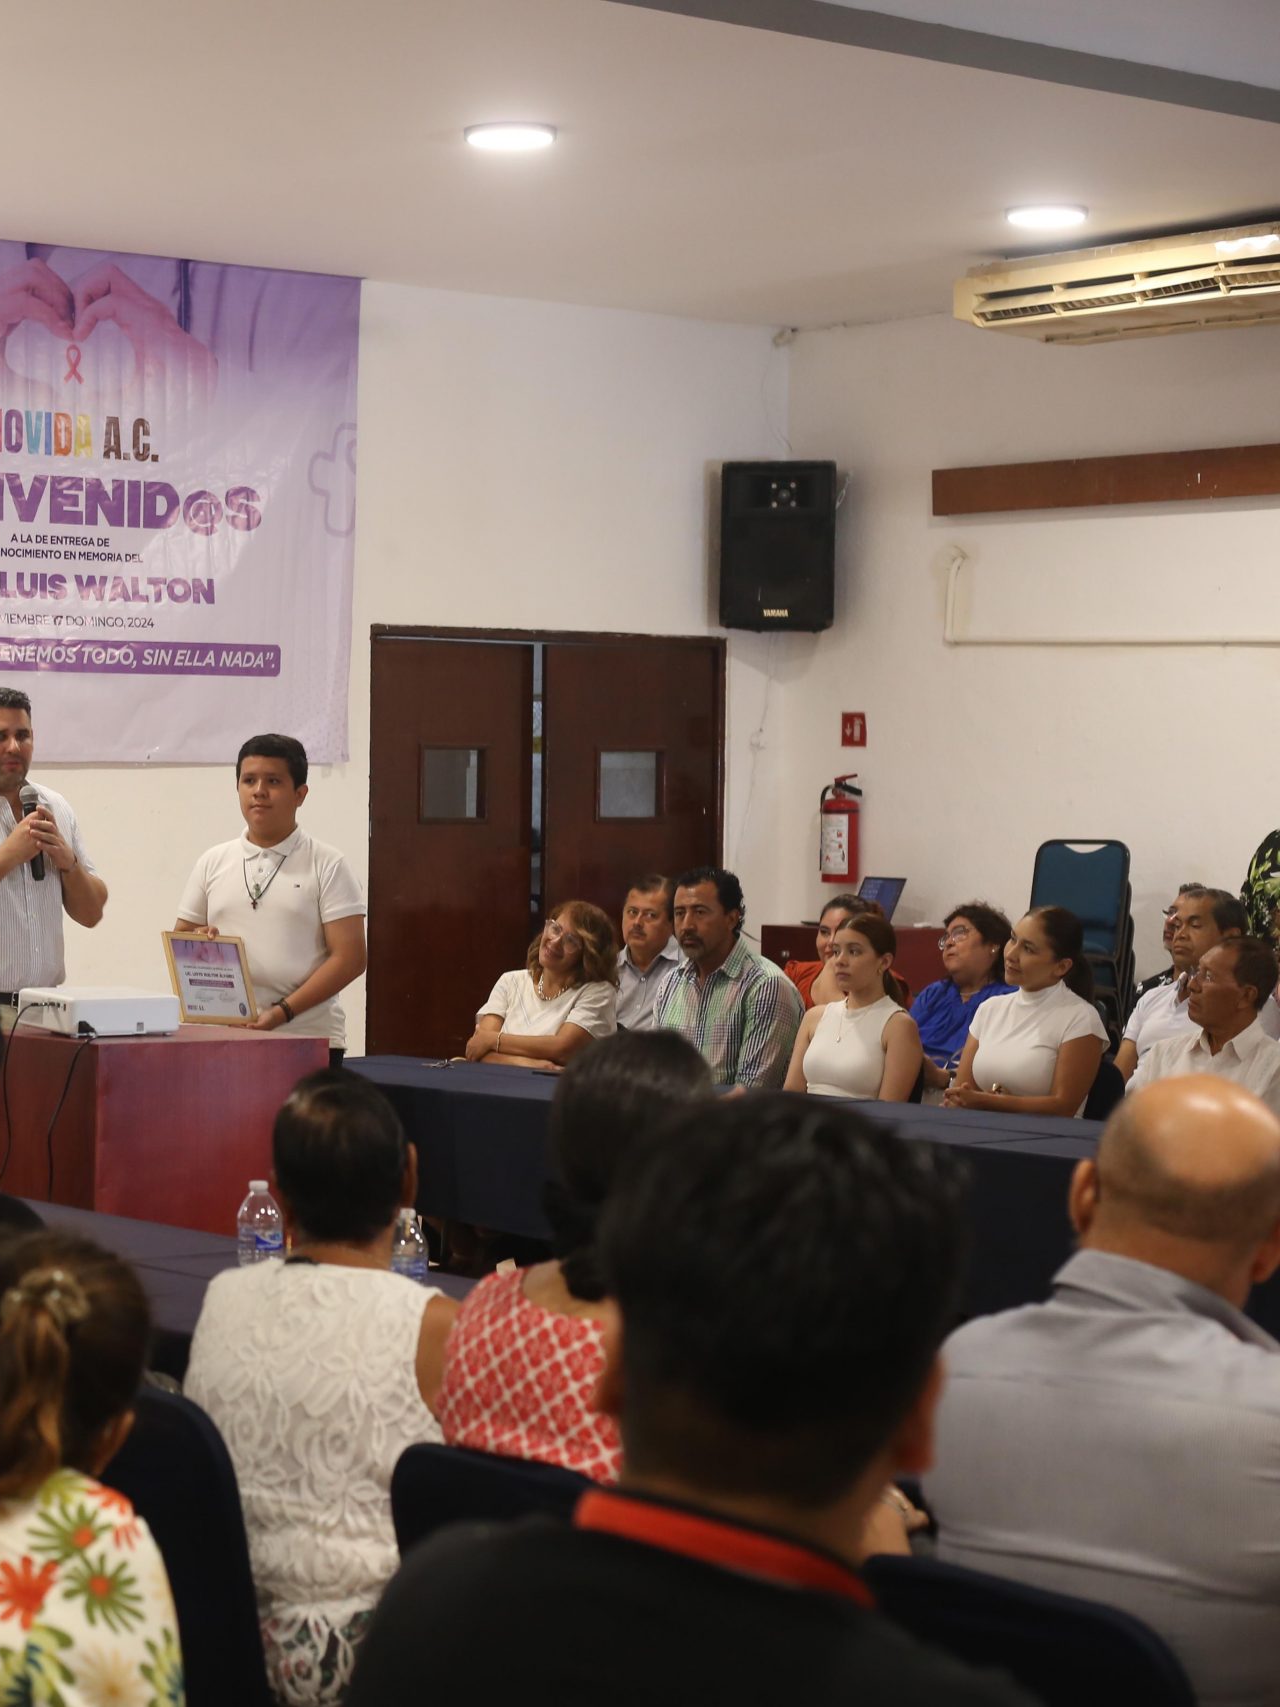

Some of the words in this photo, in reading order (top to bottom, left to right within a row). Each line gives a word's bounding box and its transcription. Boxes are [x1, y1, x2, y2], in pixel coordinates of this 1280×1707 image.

[103, 416, 159, 462] A.C.
[10, 533, 18, 543] A
[20, 533, 33, 544] LA
[35, 534, 48, 544] DE
[50, 535, 95, 546] ENTREGA
[97, 537, 110, 547] DE
[63, 550, 76, 560] EN
[78, 551, 122, 562] MEMORIA
[125, 553, 143, 563] DEL
[0, 570, 68, 600] LUIS
[74, 574, 216, 604] WALTON
[763, 608, 789, 617] YAMAHA
[65, 614, 125, 629] DOMINGO,
[128, 616, 155, 628] 2024
[82, 646, 137, 668] TODO,
[142, 649, 171, 666] SIN
[174, 650, 215, 667] ELLA
